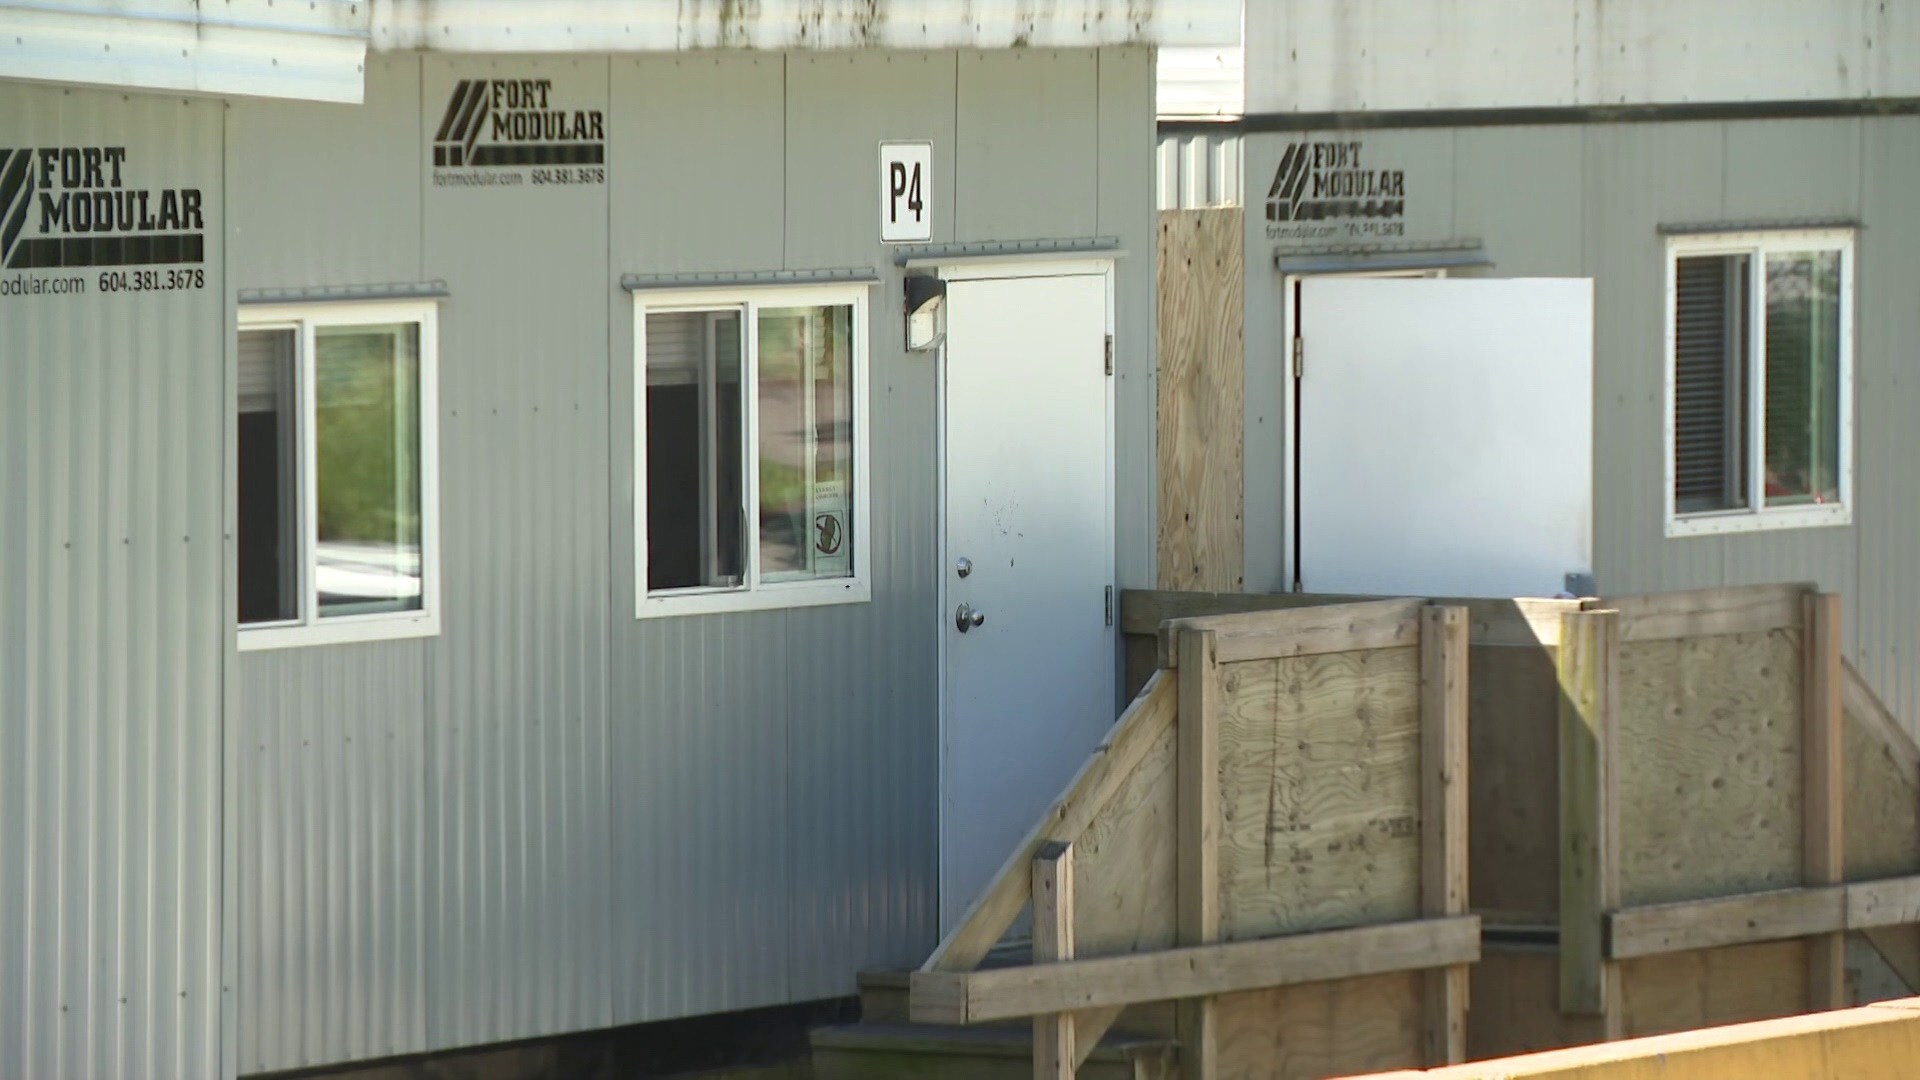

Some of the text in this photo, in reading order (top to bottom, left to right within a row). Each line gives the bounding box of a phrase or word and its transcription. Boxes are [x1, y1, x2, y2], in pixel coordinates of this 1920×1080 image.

[491, 79, 552, 109] FORT
[491, 110, 604, 141] MODULAR
[38, 147, 125, 189] FORT
[1312, 141, 1363, 169] FORT
[433, 167, 605, 187] fortmodular.com 604.381.3678
[890, 161, 923, 223] P4
[1312, 170, 1405, 198] MODULAR
[38, 189, 204, 233] MODULAR
[99, 269, 204, 292] 604.381.3678
